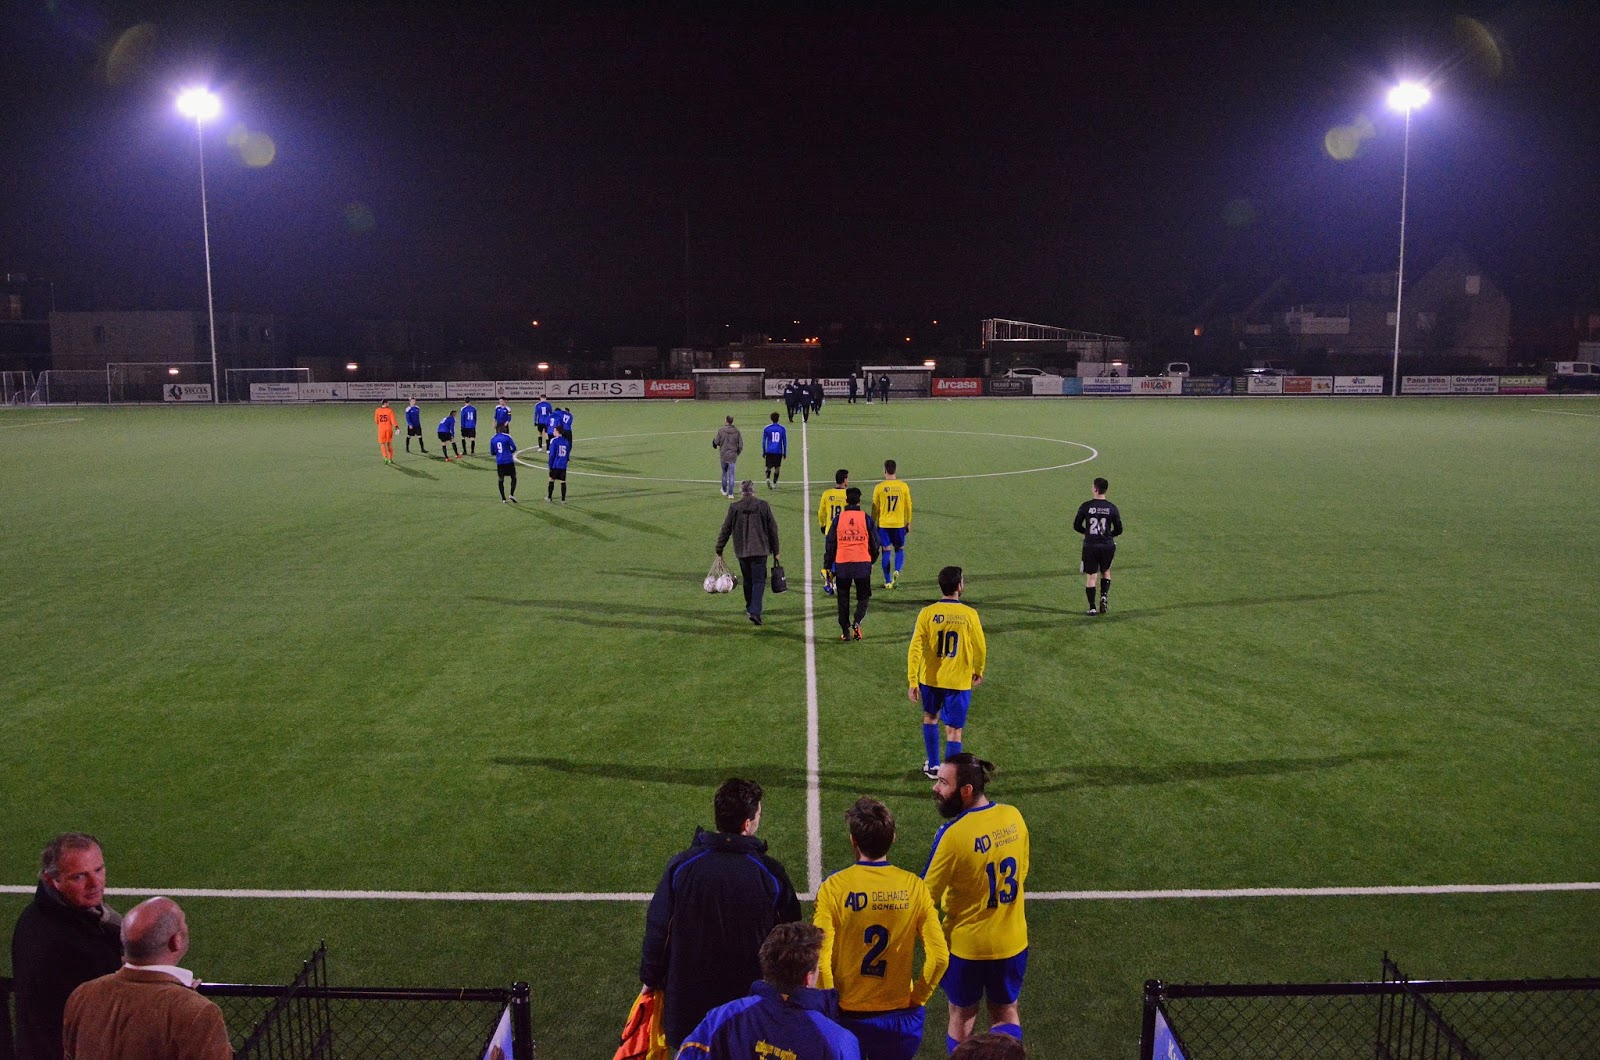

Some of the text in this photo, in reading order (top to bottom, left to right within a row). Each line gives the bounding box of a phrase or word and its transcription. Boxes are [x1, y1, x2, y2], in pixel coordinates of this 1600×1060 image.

[567, 382, 623, 395] AERTS
[649, 380, 690, 391] Arcasa
[937, 380, 978, 389] Arcasa
[379, 414, 388, 422] 25
[771, 431, 780, 442] 10
[496, 441, 503, 453] 9
[558, 445, 567, 457] 15
[886, 495, 899, 513] 17
[849, 518, 854, 527] 4
[932, 614, 945, 624] AD
[936, 630, 959, 658] 10
[992, 823, 1018, 841] DELHAIZE
[974, 834, 992, 854] AD
[986, 856, 1019, 909] 13
[844, 891, 868, 912] AD
[871, 889, 909, 902] DELHAIZE
[871, 902, 910, 911] SCHELLE
[860, 924, 889, 978] 2
